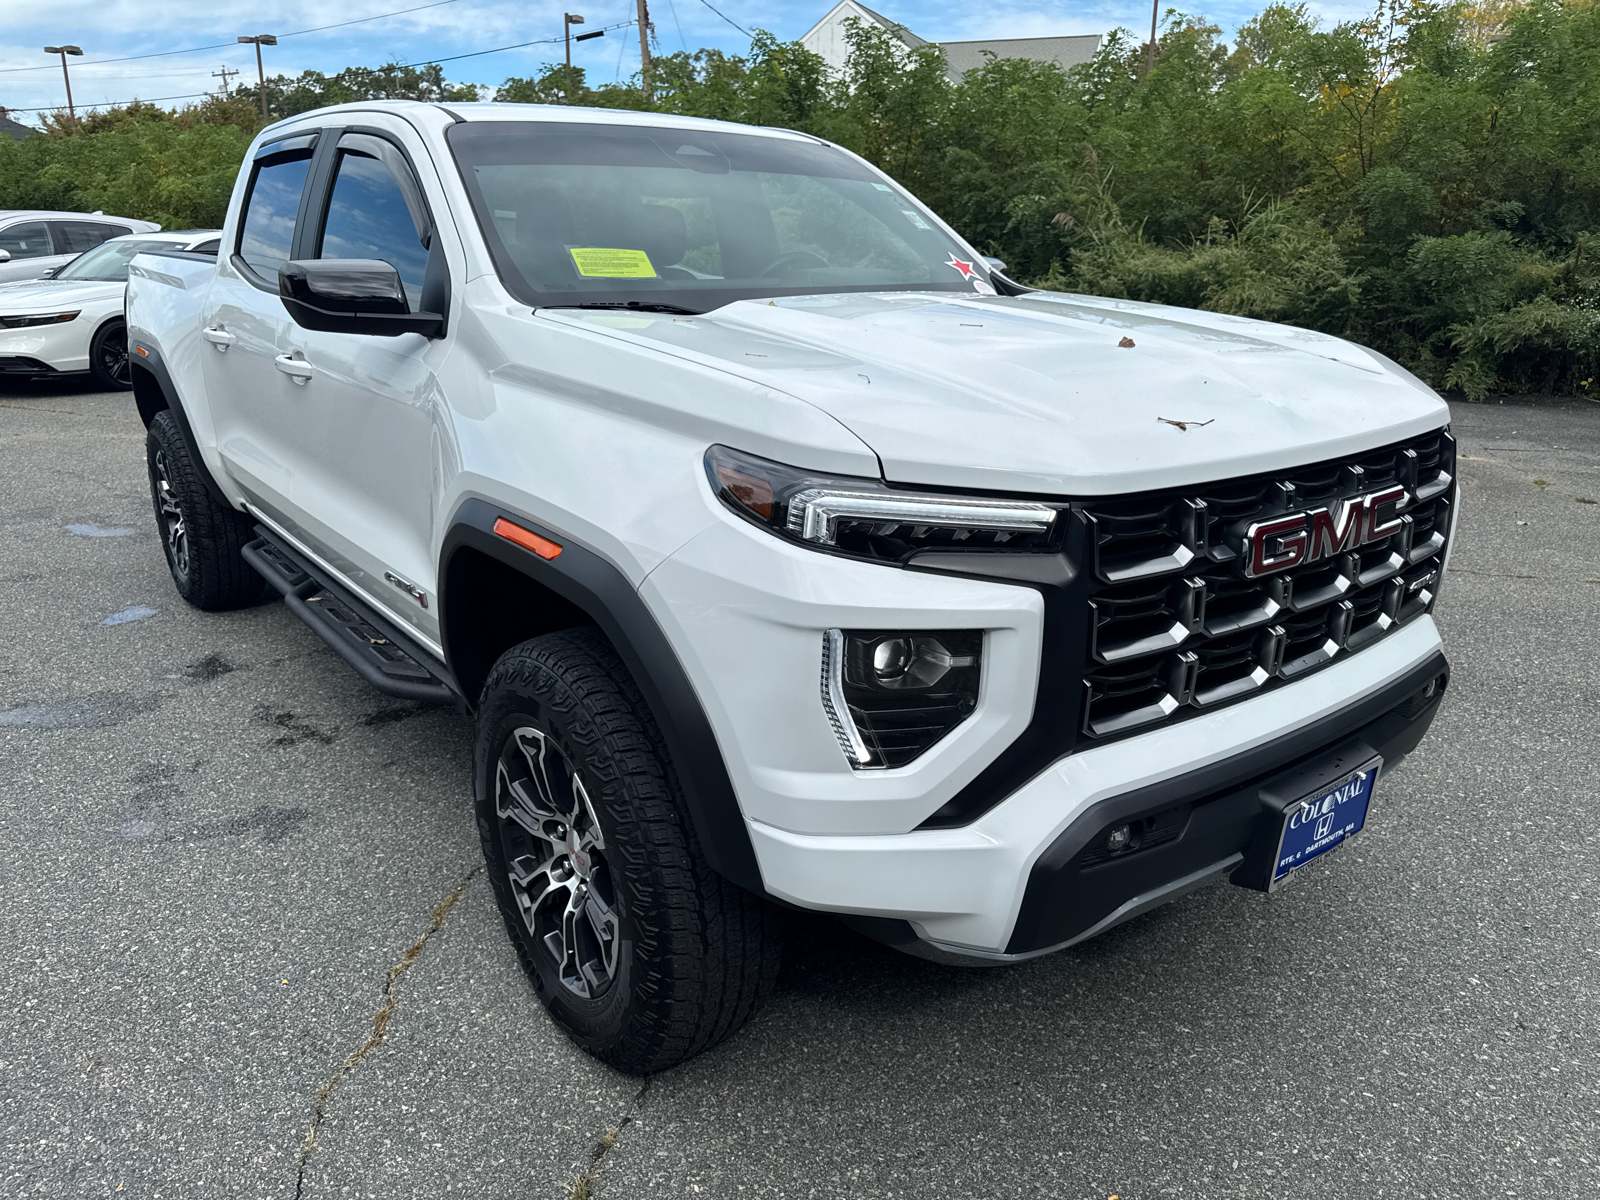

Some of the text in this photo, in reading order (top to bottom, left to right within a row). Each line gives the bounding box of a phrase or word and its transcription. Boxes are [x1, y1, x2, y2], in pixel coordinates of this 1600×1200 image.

[1245, 484, 1405, 578] GMC
[1290, 781, 1364, 829] COLONIAL
[1280, 855, 1295, 867] RTE.
[1345, 823, 1354, 833] MA
